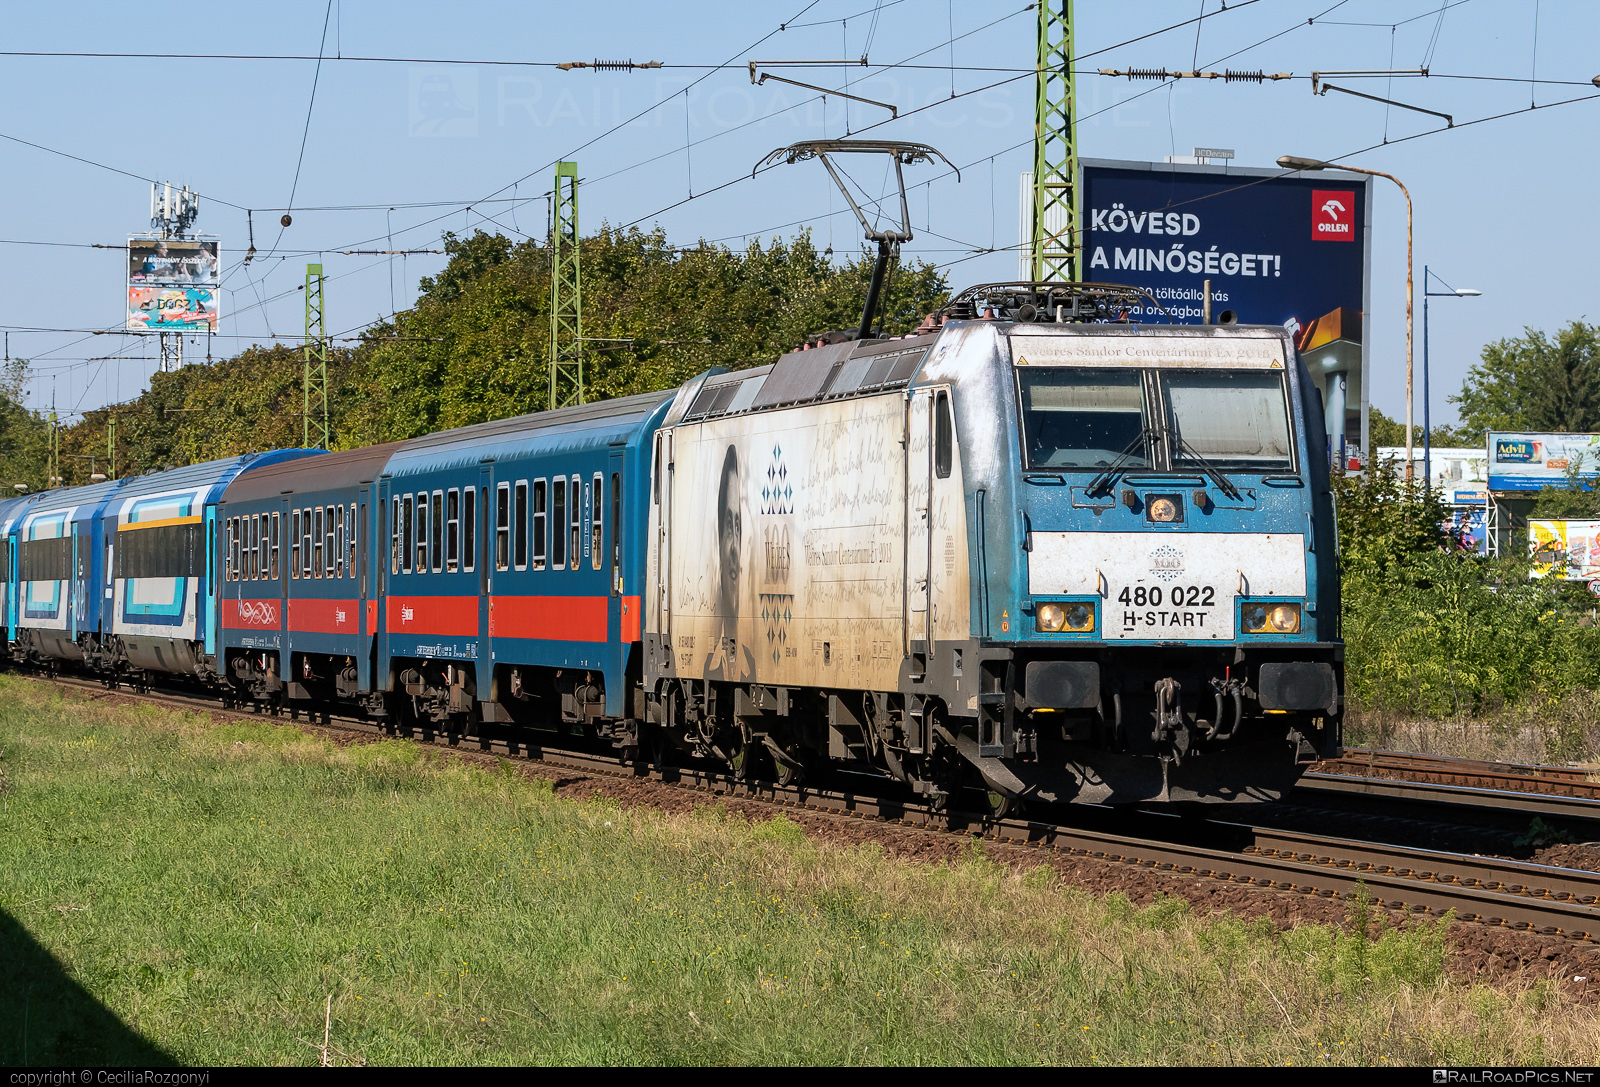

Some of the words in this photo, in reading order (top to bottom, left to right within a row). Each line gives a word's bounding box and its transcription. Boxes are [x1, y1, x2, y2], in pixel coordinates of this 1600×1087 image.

[1196, 149, 1233, 157] JCDecaux
[1092, 203, 1200, 236] KÖVESD
[1318, 223, 1348, 233] ORLEN
[1090, 247, 1110, 269] A
[1114, 244, 1281, 277] MINŐSÉGET!
[1076, 345, 1121, 357] Sándor
[1498, 444, 1526, 454] Advil
[1118, 586, 1163, 607] 480
[1170, 586, 1215, 607] 022
[1123, 610, 1208, 628] H-START
